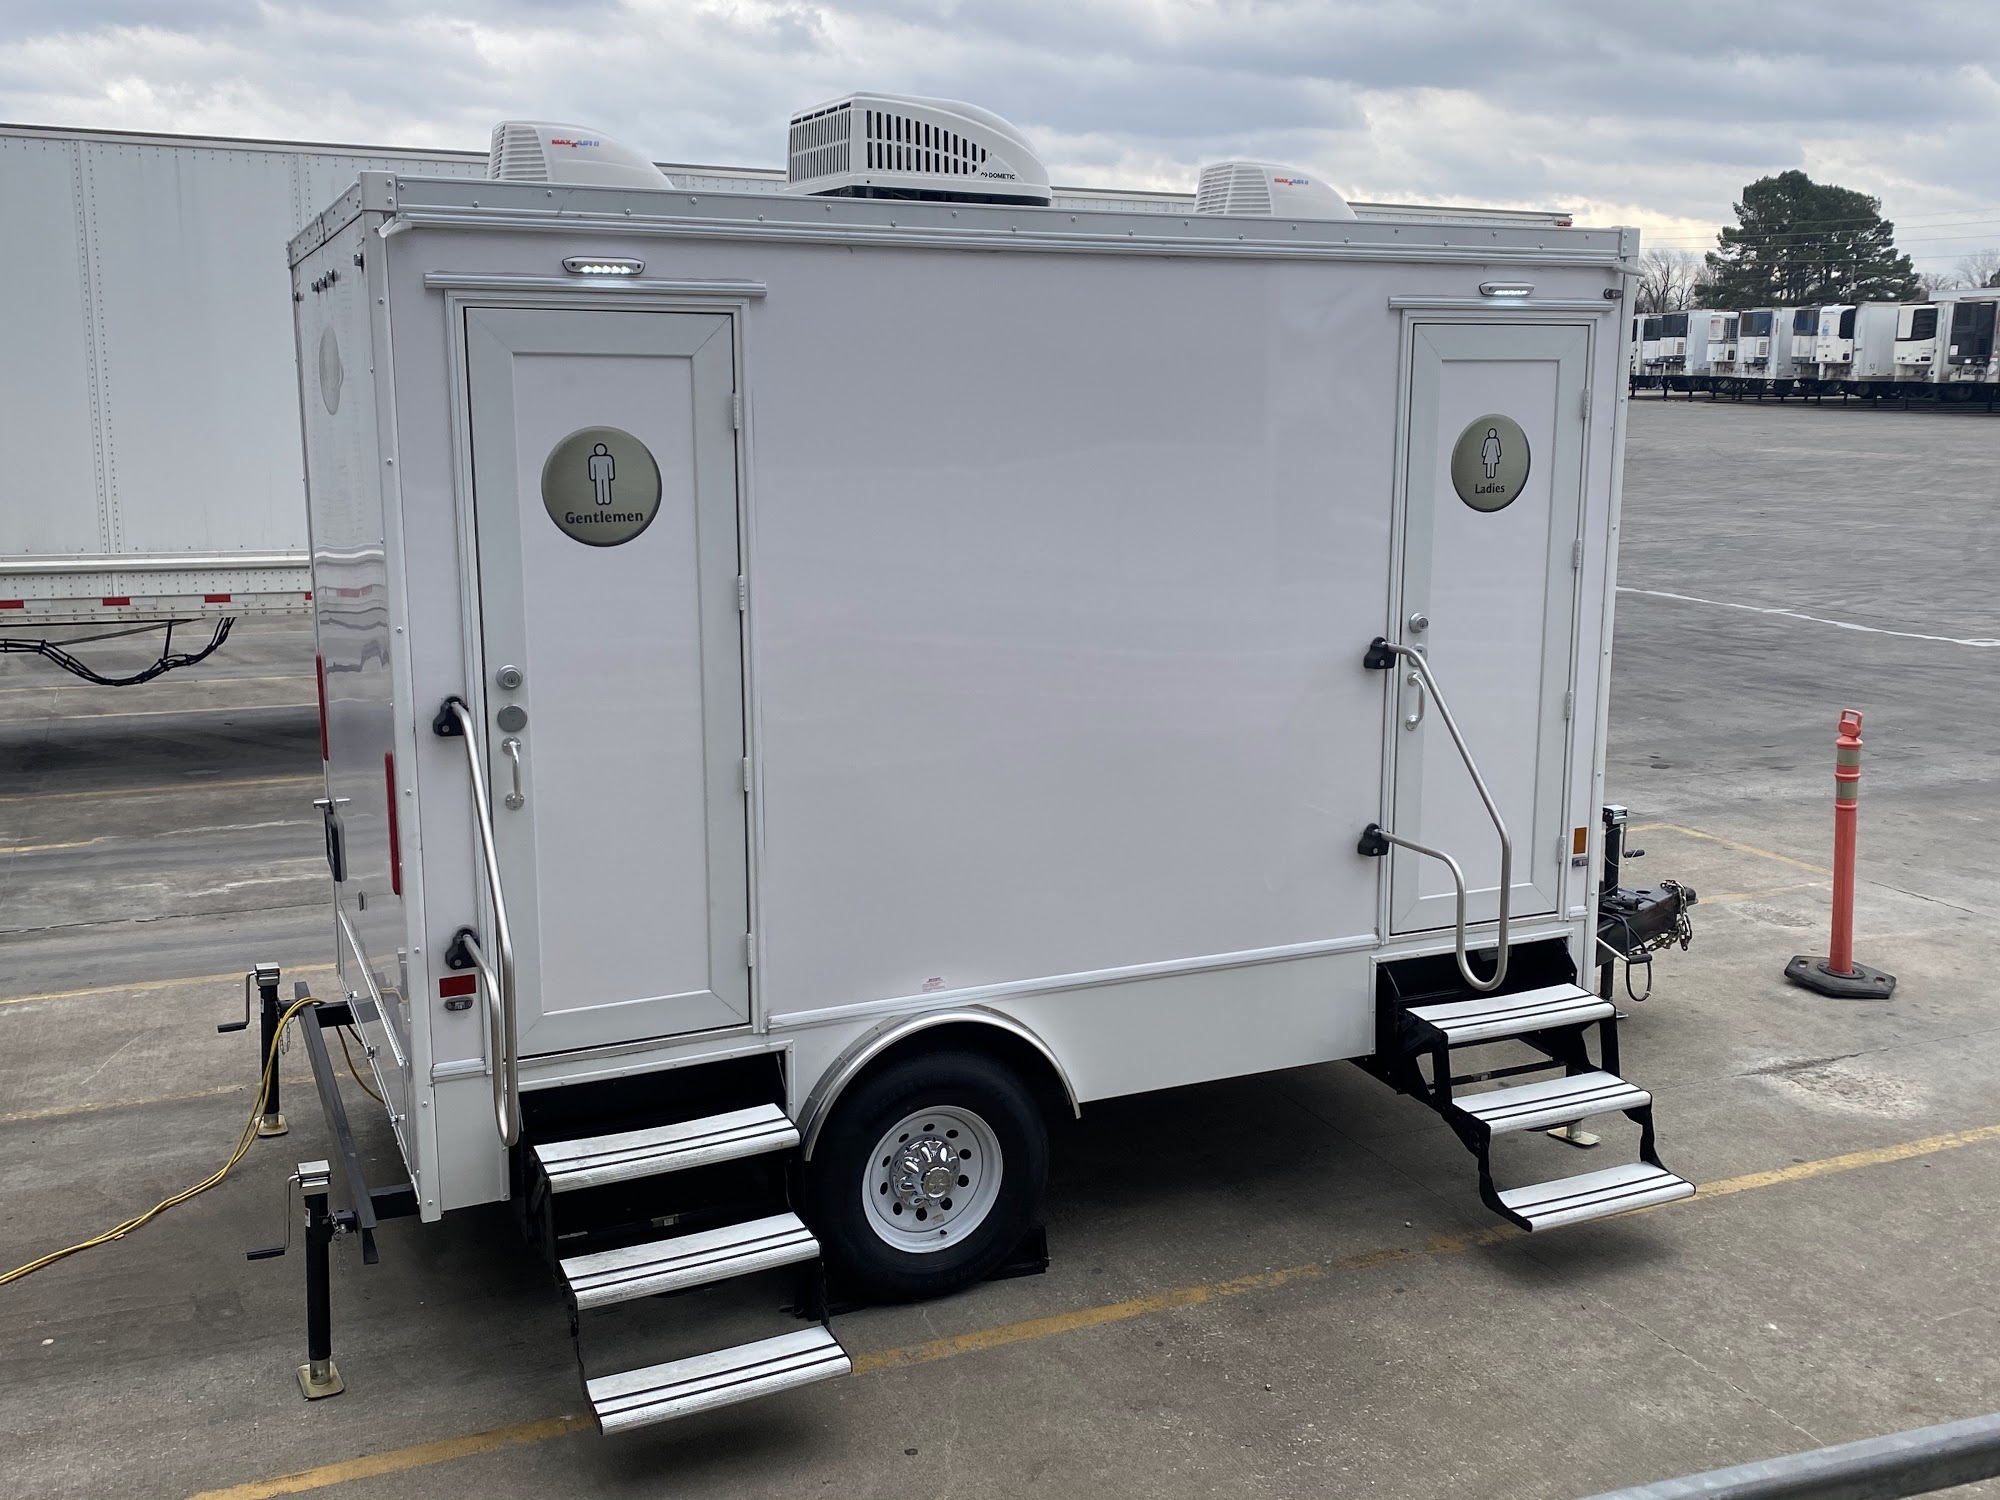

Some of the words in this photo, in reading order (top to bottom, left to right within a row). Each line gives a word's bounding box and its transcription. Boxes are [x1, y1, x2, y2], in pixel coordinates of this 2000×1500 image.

[988, 172, 1016, 180] DOMETIC
[1474, 482, 1506, 494] Ladies
[564, 510, 644, 525] Gentlemen
